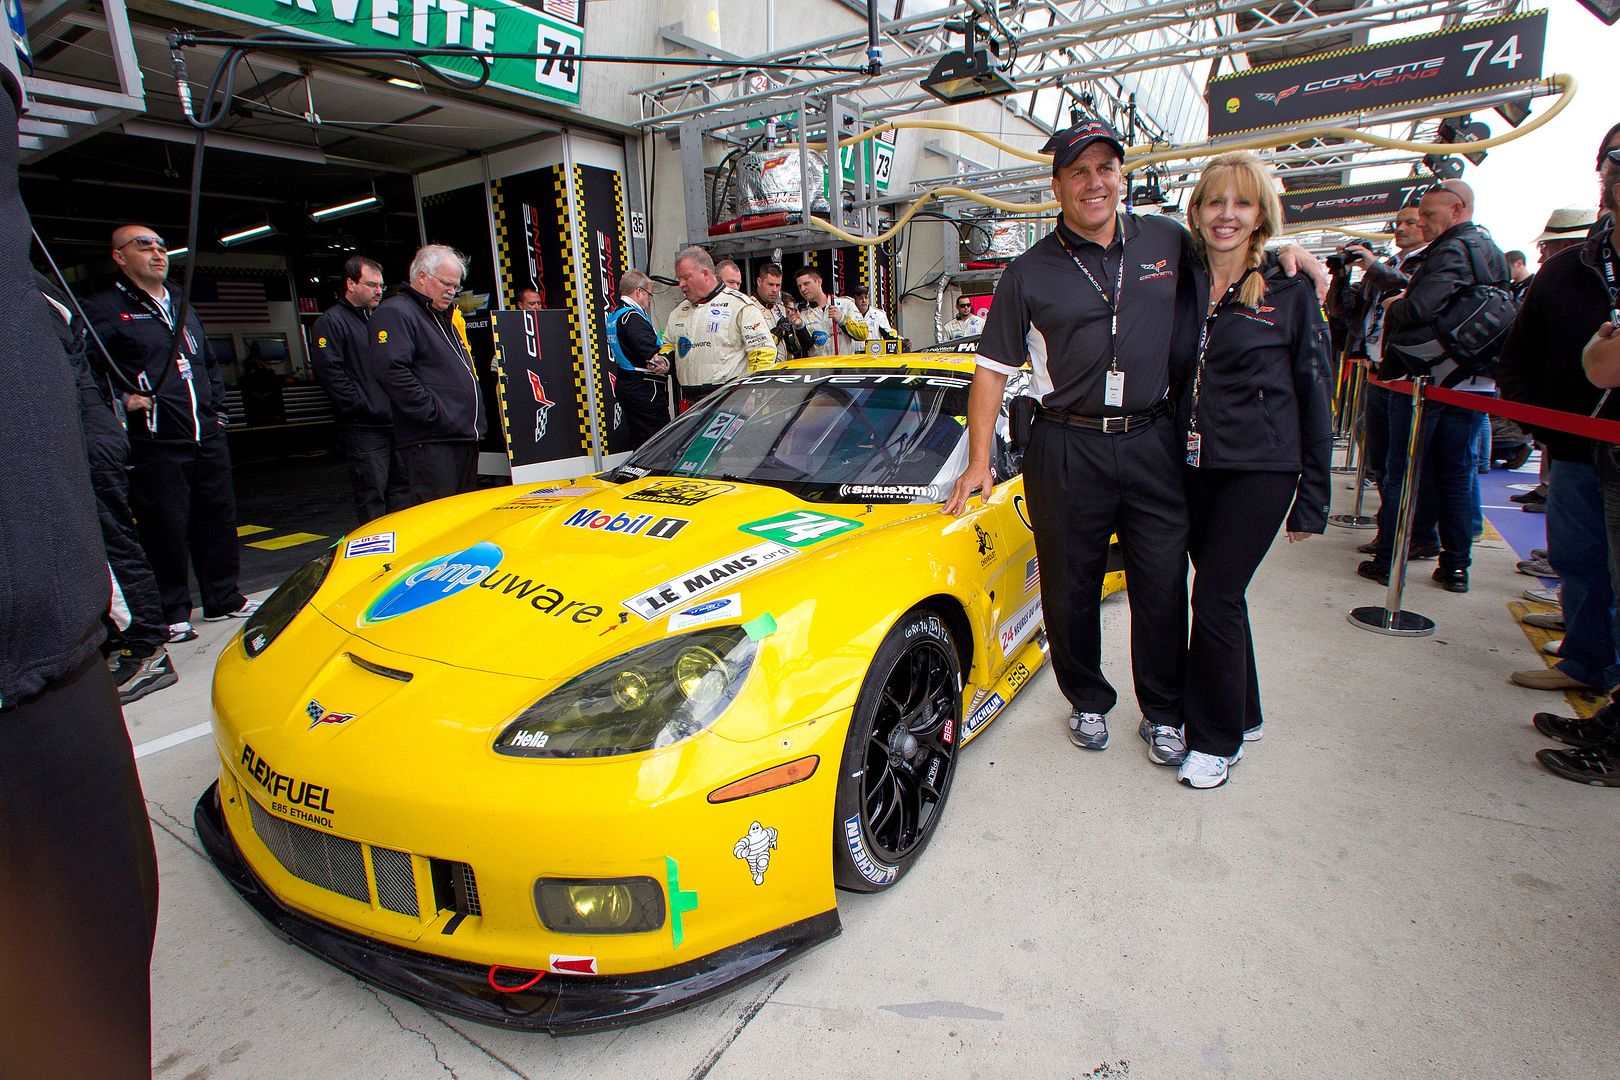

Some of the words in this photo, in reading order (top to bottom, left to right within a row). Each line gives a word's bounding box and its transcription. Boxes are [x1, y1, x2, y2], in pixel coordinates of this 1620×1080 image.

[542, 37, 575, 83] 74
[1462, 34, 1523, 77] 74
[1304, 56, 1446, 92] CORVETTE
[1344, 69, 1439, 93] RACING
[876, 154, 890, 178] 73
[1316, 192, 1390, 207] CORVETTE
[632, 217, 644, 234] 35
[628, 494, 698, 505] CHEVROLET
[851, 485, 928, 497] SiriusXM
[563, 508, 654, 534] Mobil
[748, 512, 850, 543] 74
[980, 550, 997, 567] CHEVROLET
[405, 561, 603, 624] Compuware
[646, 587, 680, 611] LE
[682, 554, 758, 593] MANS
[1001, 625, 1014, 652] 24
[1006, 662, 1029, 692] BBS
[969, 695, 1001, 729] MICHELIN
[510, 730, 550, 748] Hella
[943, 719, 953, 742] BBS
[271, 802, 288, 814] E85
[290, 807, 334, 829] ETHANOL
[846, 821, 887, 883] MICHELIN
